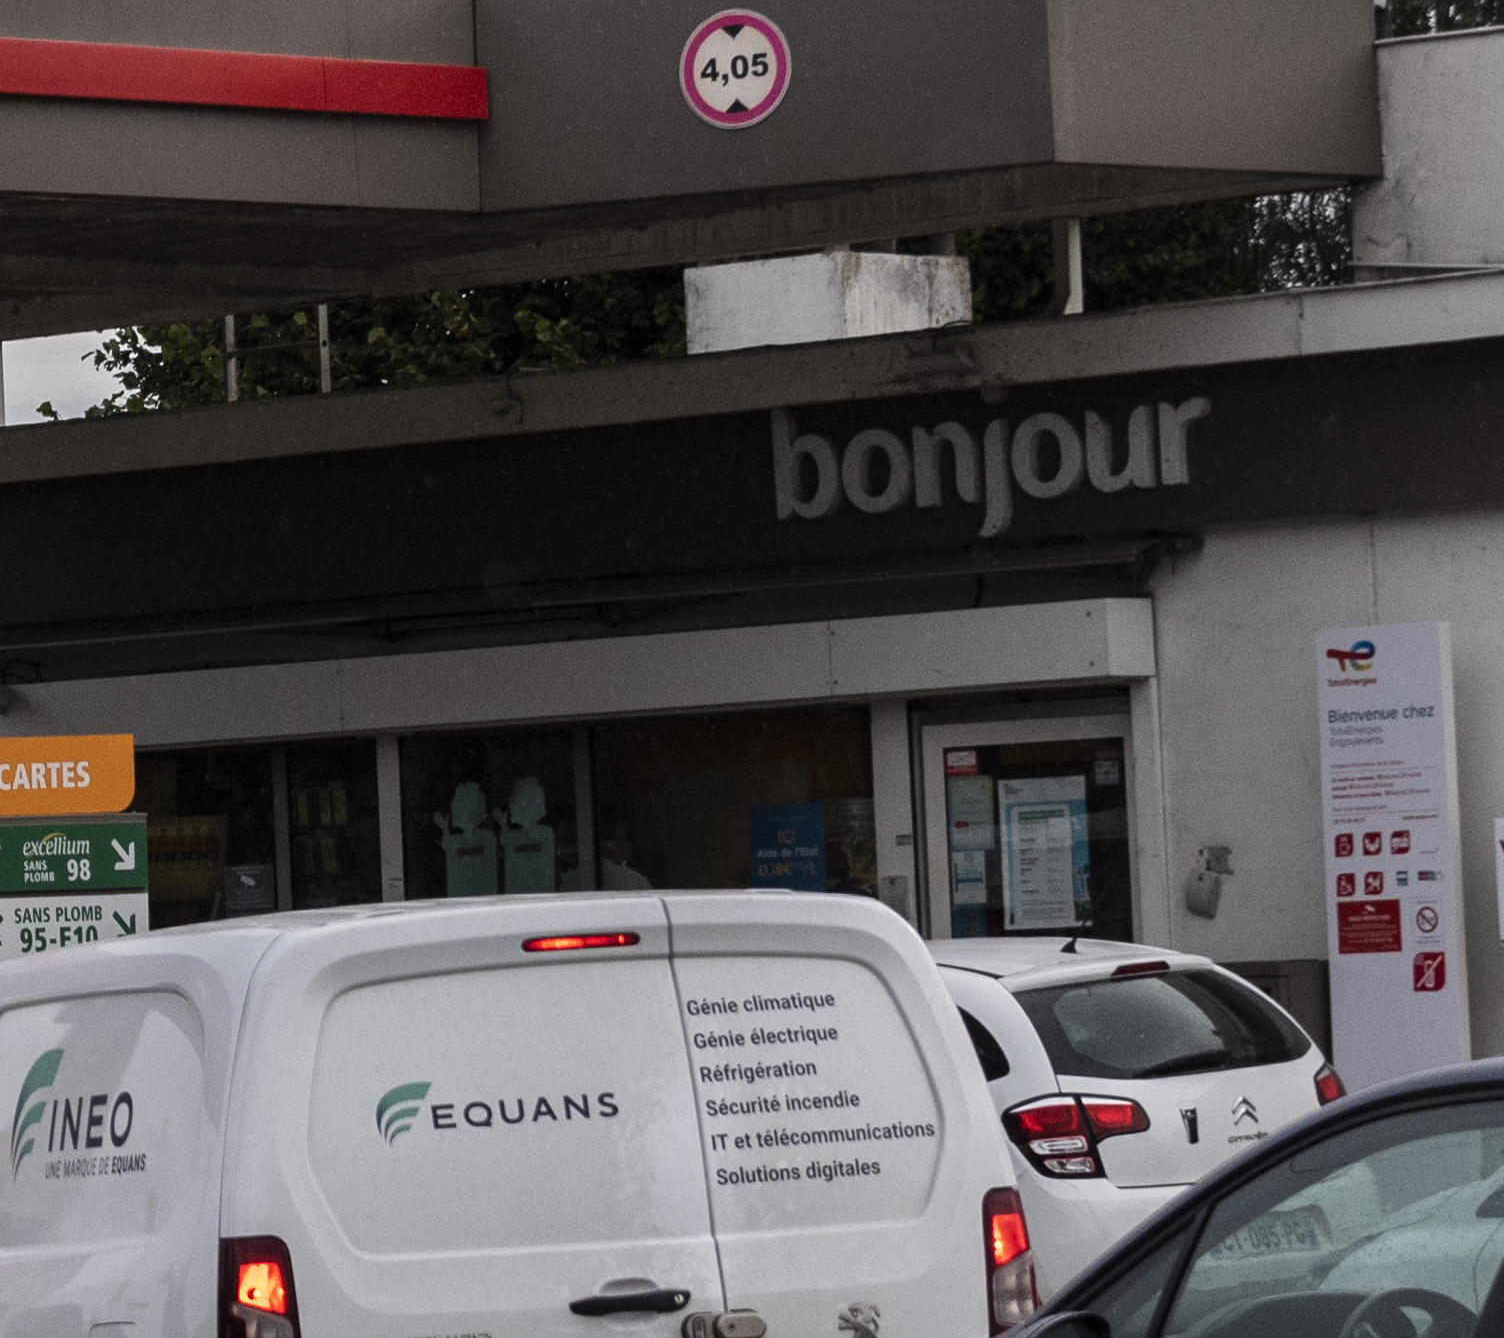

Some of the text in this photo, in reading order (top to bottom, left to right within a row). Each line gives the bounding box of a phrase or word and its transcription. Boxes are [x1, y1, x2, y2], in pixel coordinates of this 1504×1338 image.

[700, 51, 770, 87] 4,05
[771, 394, 1211, 537] bonjour
[1328, 704, 1435, 724] Bienvenue chez
[23, 835, 91, 856] excellium
[24, 860, 48, 871] SANS
[24, 872, 55, 883] PLOMB
[66, 858, 91, 881] 98
[14, 905, 103, 924] SANS PLOMB
[686, 992, 836, 1016] Génie climatique
[693, 1026, 838, 1049] Génie électrique
[699, 1060, 817, 1083] Réfrigération
[431, 1091, 619, 1132] EQUANS
[705, 1090, 860, 1116] Sécurité incendie
[48, 1091, 133, 1152] INEO
[711, 1121, 935, 1151] IT et télécommunications
[45, 1153, 147, 1179] UNE MARQUE DE EQUANS
[716, 1158, 881, 1186] Solutions digitales
